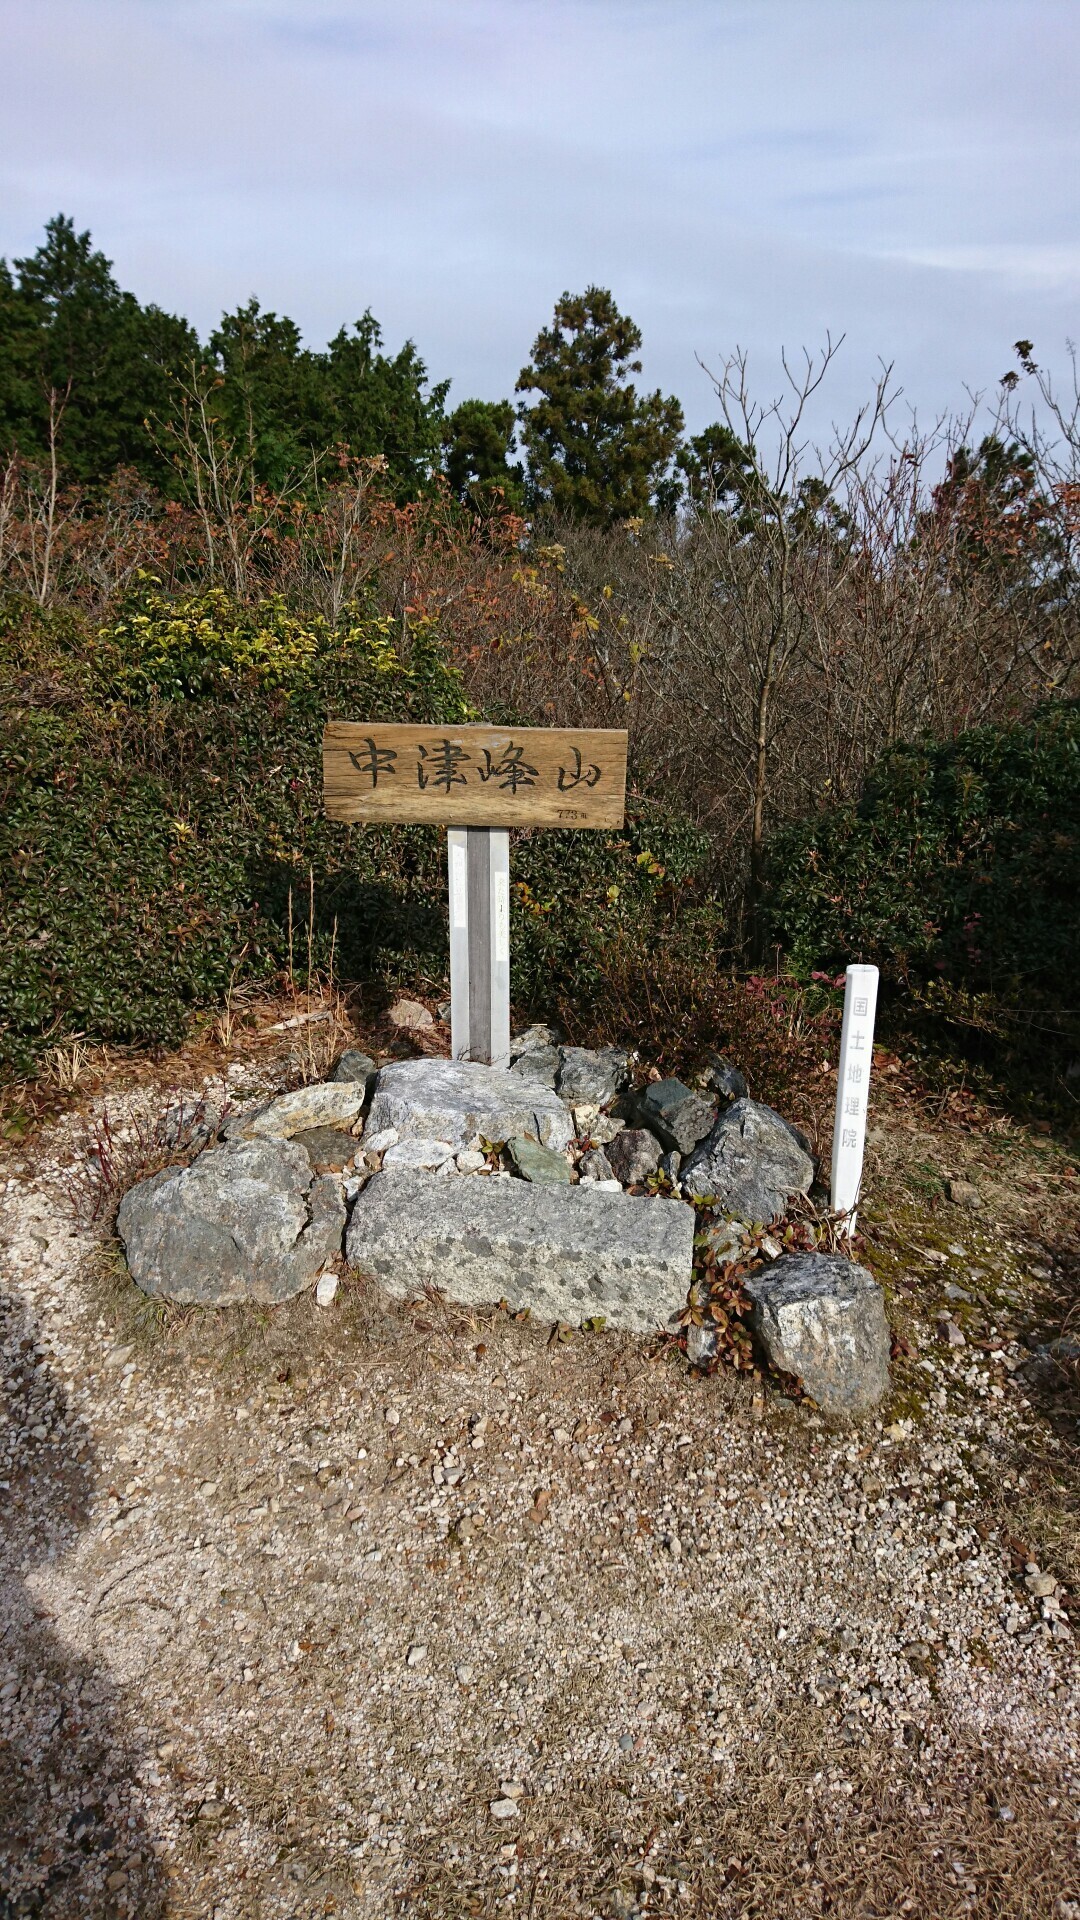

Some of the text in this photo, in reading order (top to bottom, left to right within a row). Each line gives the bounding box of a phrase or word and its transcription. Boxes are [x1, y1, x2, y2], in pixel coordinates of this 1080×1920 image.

[348, 738, 601, 795] 中津峰山
[841, 997, 868, 1149] 国土地理院
